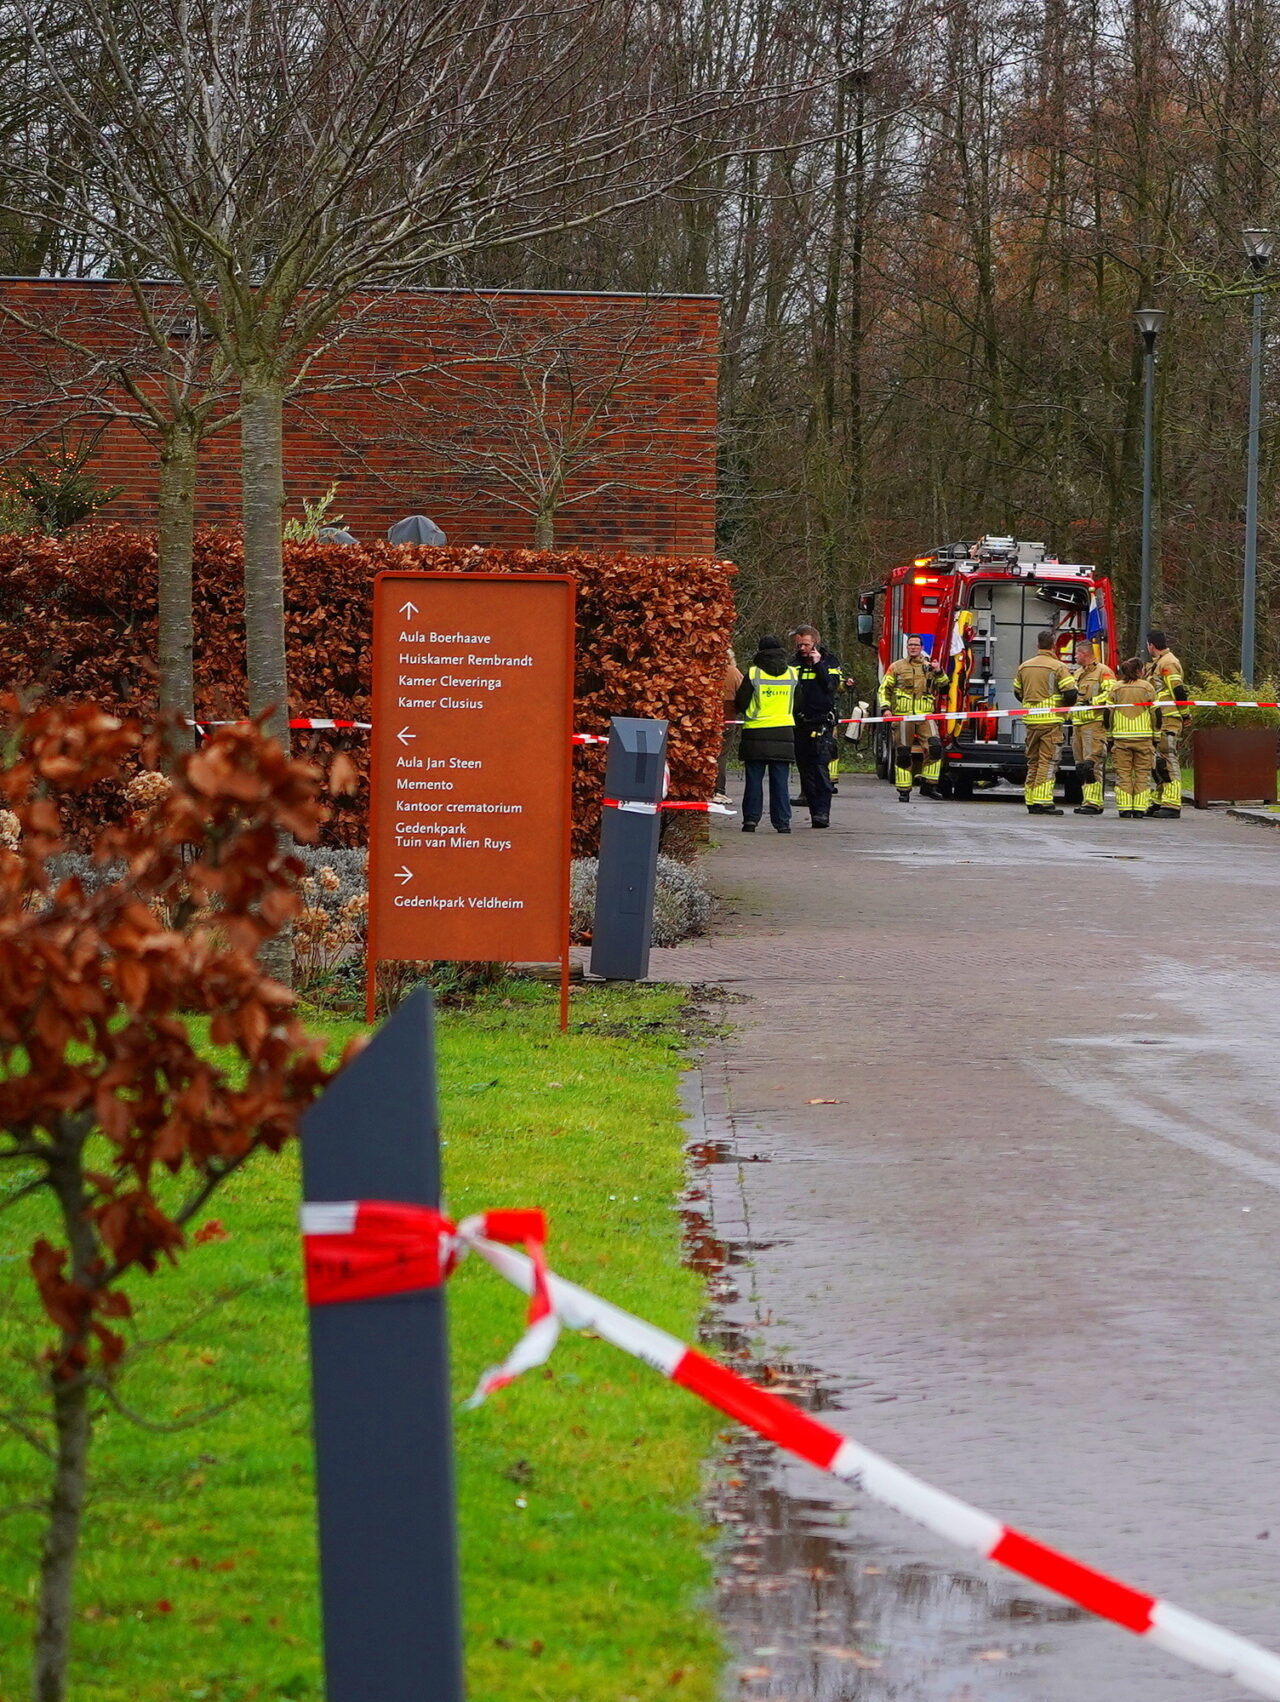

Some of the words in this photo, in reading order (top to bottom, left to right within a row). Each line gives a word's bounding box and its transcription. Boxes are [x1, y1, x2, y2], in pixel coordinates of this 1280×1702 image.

[399, 631, 426, 643] Aula
[430, 632, 491, 644] Boerhaave
[399, 653, 464, 665] Huiskamer
[468, 654, 533, 666] Rembrandt
[399, 675, 437, 686] Kamer
[440, 676, 501, 691] Cleveringa
[398, 697, 436, 708] Kamer
[439, 697, 483, 709] Clusius
[396, 756, 423, 768] Aula
[426, 757, 445, 770] Jan
[449, 758, 482, 769] Steen
[396, 778, 453, 790] Memento
[396, 801, 443, 812] Kantoor
[446, 803, 522, 814] crematorium
[395, 822, 466, 836] Gedenkpark
[395, 836, 422, 847] Tuin
[425, 839, 446, 848] van
[450, 837, 480, 848] Mien
[484, 838, 512, 852] Ruys
[394, 896, 465, 910] Gedenkpark
[468, 897, 523, 909] Veldheim
